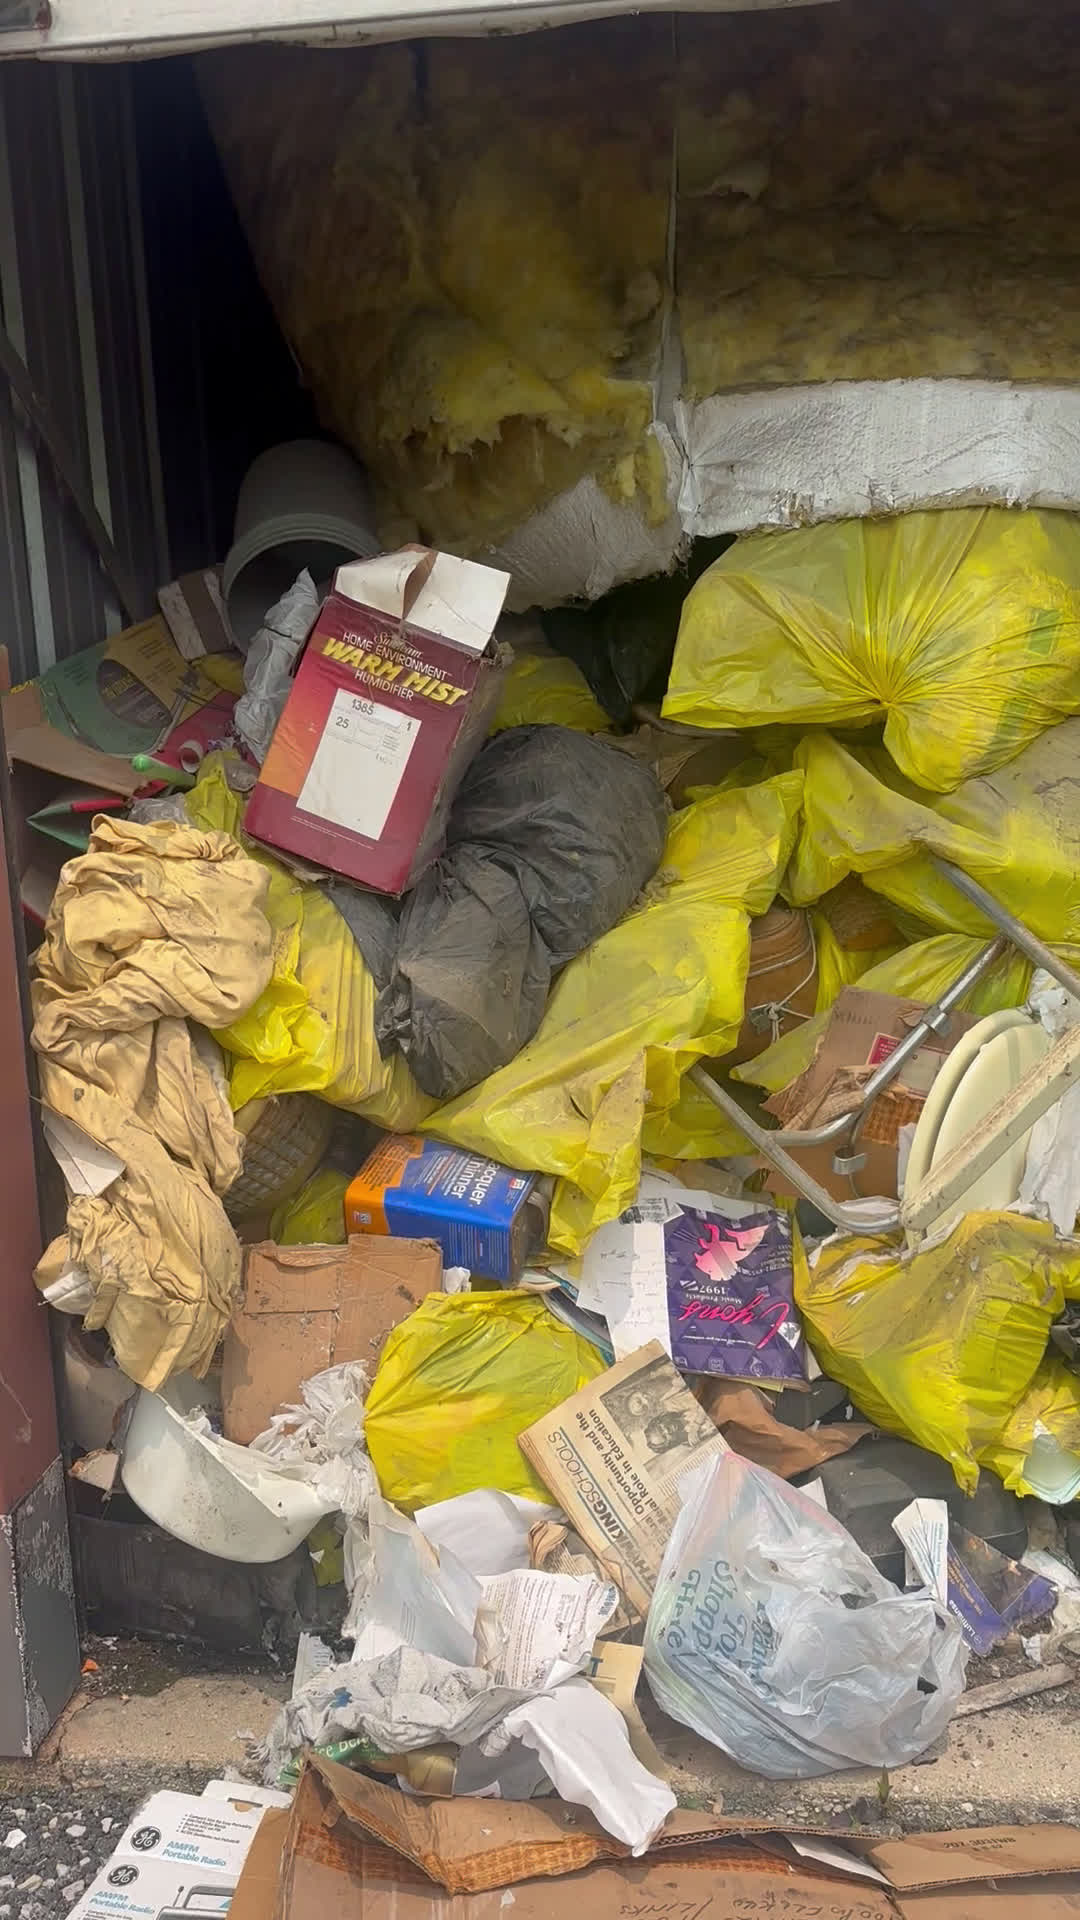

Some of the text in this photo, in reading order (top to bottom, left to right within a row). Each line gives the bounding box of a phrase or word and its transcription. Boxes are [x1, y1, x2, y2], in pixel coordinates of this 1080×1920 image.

[342, 631, 448, 681] HOME ENVIRONMENT
[321, 637, 469, 705] WARM MIST
[354, 669, 414, 702] HUMIDIFIER
[335, 716, 350, 730] 25
[468, 1161, 500, 1205] acquer
[698, 1284, 727, 1295] 1997
[677, 1290, 790, 1350] Lyons
[574, 1411, 592, 1432] the
[588, 1408, 626, 1461] Education
[584, 1430, 605, 1452] and
[621, 1459, 634, 1473] in
[601, 1450, 646, 1517] Opportunity
[629, 1473, 651, 1501] Role
[161, 1849, 227, 1867] Portable Radio
[88, 1898, 129, 1911] Portable
[128, 1903, 156, 1915] Radio
